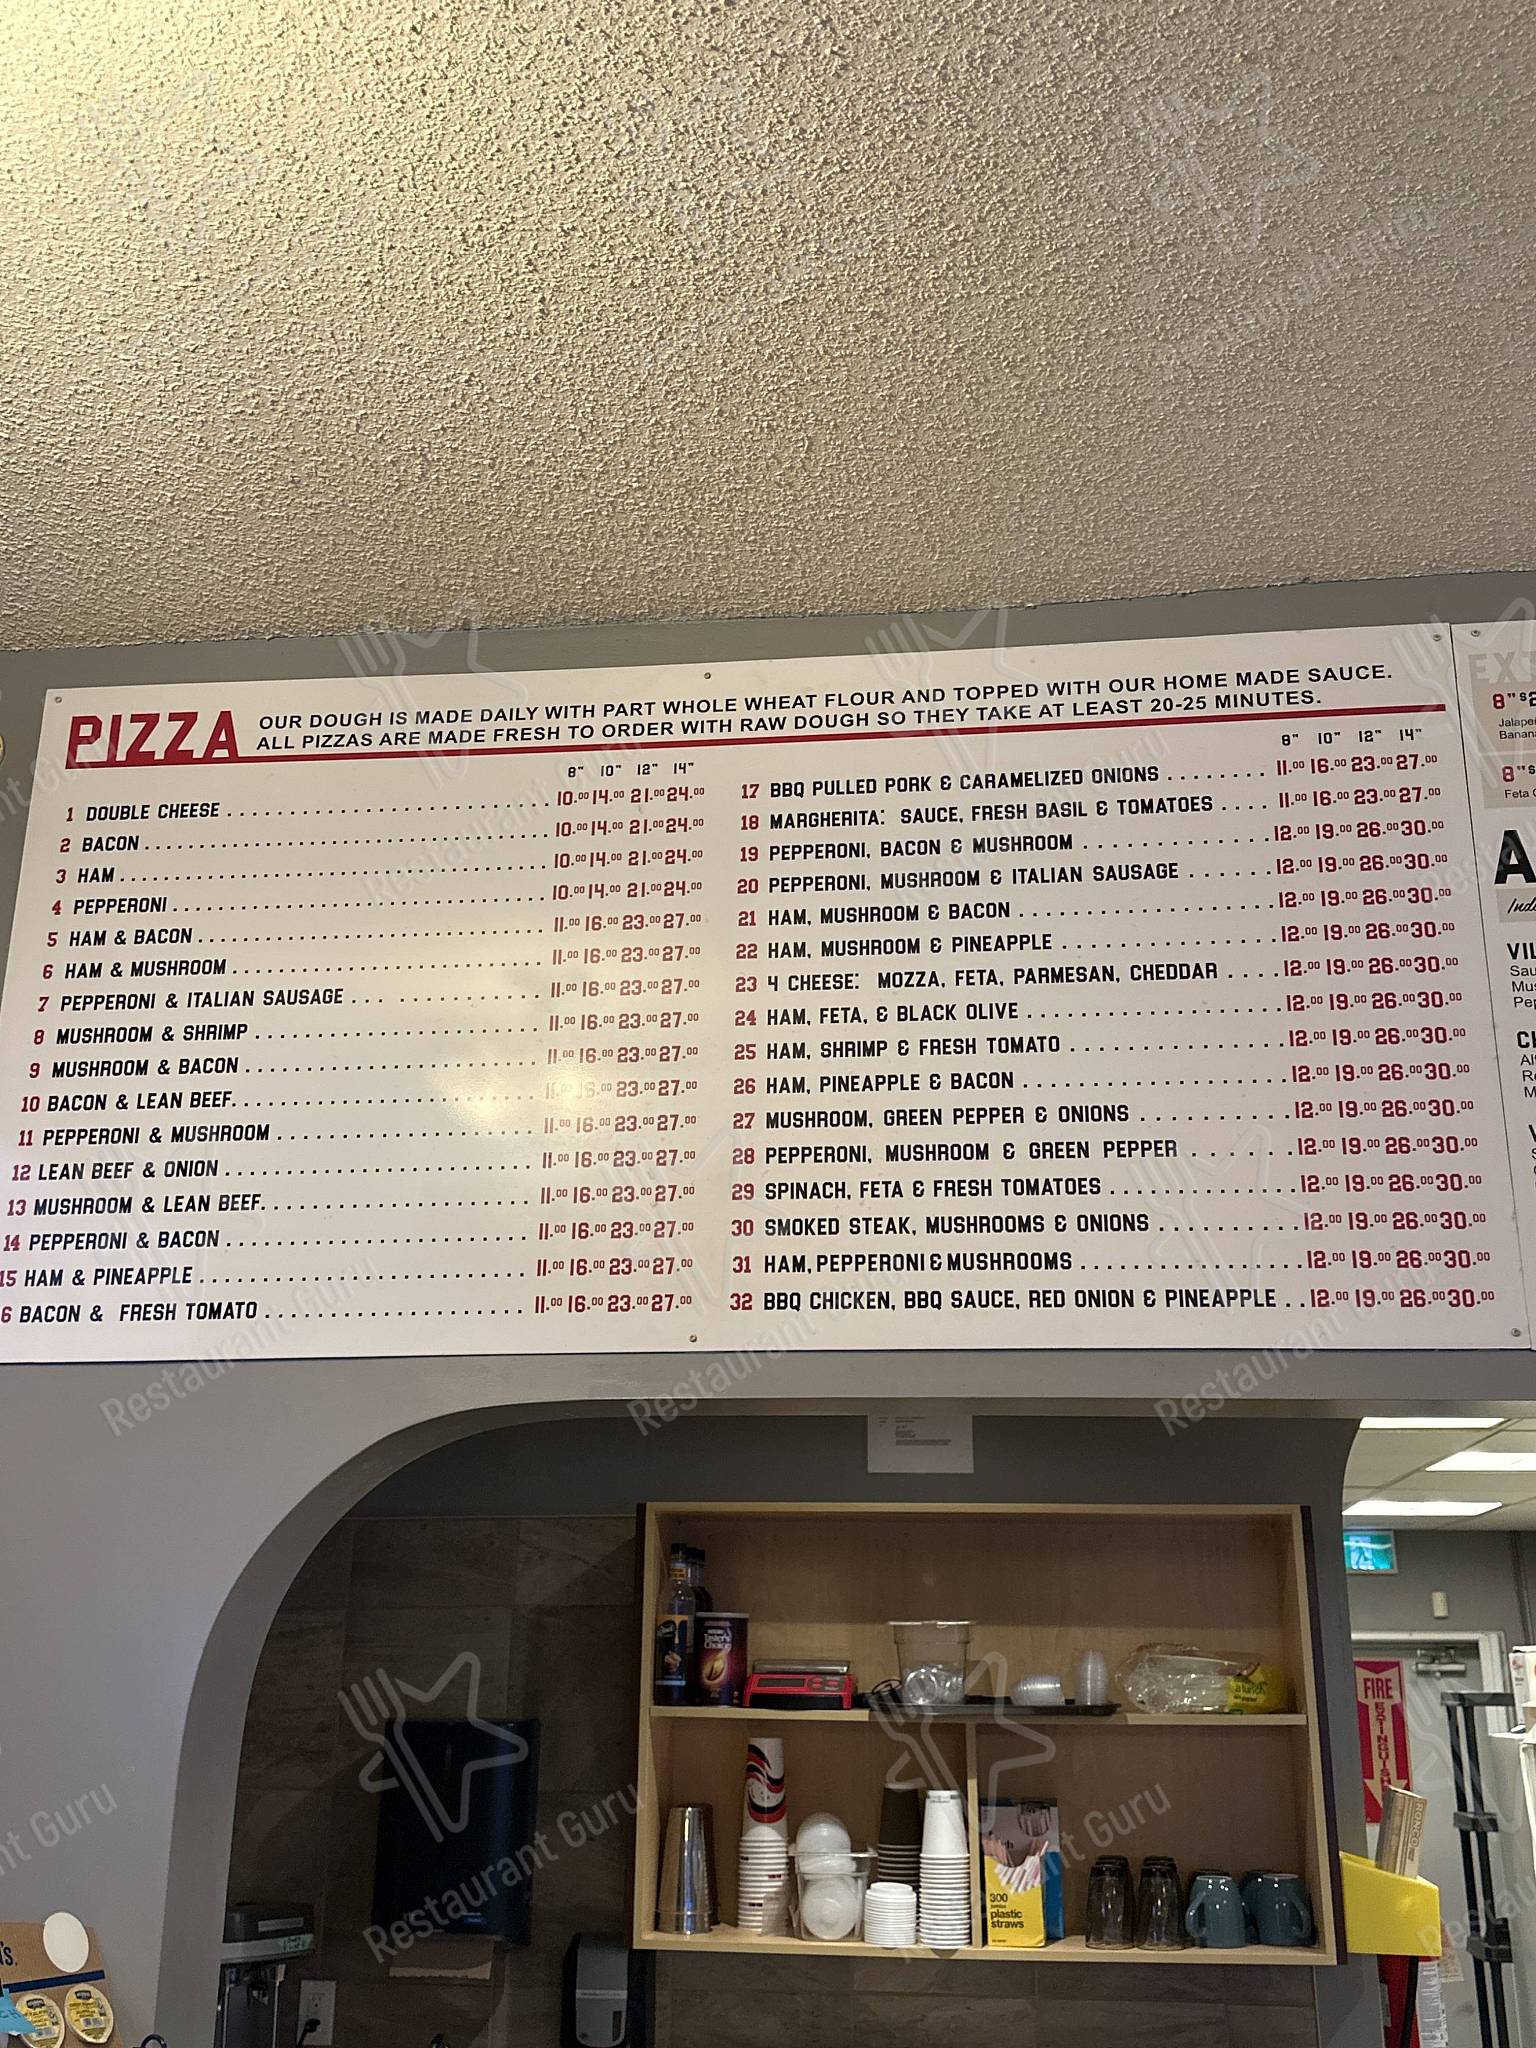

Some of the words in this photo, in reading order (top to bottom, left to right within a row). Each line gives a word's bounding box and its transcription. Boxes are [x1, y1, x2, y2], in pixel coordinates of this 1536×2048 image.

[260, 715, 302, 729] OUR
[310, 712, 382, 728] DOUGH
[390, 712, 407, 725] IS
[416, 710, 472, 724] MADE
[481, 707, 539, 722] DAILY
[545, 705, 595, 719] WITH
[604, 702, 656, 717] PART
[663, 698, 736, 714] WHOLE
[744, 695, 817, 711] WHEAT
[825, 691, 895, 707] FLOUR
[901, 689, 945, 703] AND
[953, 684, 1038, 701] TOPPED
[1047, 680, 1100, 696] WITH
[1109, 678, 1156, 693] OUR
[1164, 673, 1227, 690] HOME
[1236, 669, 1300, 686] MADE
[1308, 665, 1391, 682] SAUCE.
[256, 736, 294, 750] ALL
[302, 733, 372, 748] PIZZAS
[379, 731, 421, 746] ARE
[429, 729, 486, 744] MADE
[494, 726, 560, 742] FRESH
[568, 725, 594, 739] TO
[602, 722, 674, 737] ORDER
[681, 719, 732, 734] WITH
[741, 716, 787, 732] RAW
[795, 713, 868, 729] DOUGH
[877, 711, 905, 725] SO
[913, 708, 969, 724] THEY
[976, 705, 1031, 720] TAKE
[1038, 703, 1064, 718] AT
[1073, 699, 1143, 716] LEAST
[1151, 696, 1206, 712] 20-25
[1215, 690, 1321, 708] MINUTES.
[66, 710, 240, 769] PIZZA
[742, 784, 759, 799] 17
[771, 782, 804, 798] BBQ
[813, 779, 877, 796] PULLED
[885, 776, 932, 793] PORK
[940, 775, 951, 790] &
[960, 770, 1083, 790] CARAMELIZED
[1092, 766, 1158, 784] ONIONS
[1505, 789, 1529, 798] Feta
[66, 807, 73, 822] 1
[86, 805, 150, 821] DOUBLE
[158, 802, 220, 819] CHEESE
[741, 815, 759, 830] 18
[770, 809, 885, 829] MARGHERITA:
[901, 806, 963, 824] SAUCE,
[972, 804, 1027, 821] FRESH
[1036, 801, 1087, 819] BASIL
[1096, 800, 1108, 816] &
[1117, 796, 1212, 815] TOMATOES
[60, 838, 71, 853] 2
[82, 835, 139, 852] BACON
[737, 878, 758, 894] 20
[769, 874, 870, 893] PEPPERONI,
[881, 870, 980, 889] MUSHROOM
[991, 869, 1002, 885] &
[1012, 866, 1082, 884] ITALIAN
[1093, 863, 1178, 881] SAUSAGE
[52, 900, 61, 915] 4
[74, 897, 167, 915] PEPPERONI
[47, 932, 58, 947] 5
[69, 930, 107, 947] HAM
[114, 930, 126, 945] &
[134, 928, 192, 944] BACON
[736, 976, 757, 992] 23
[768, 976, 778, 991] 4
[788, 973, 859, 991] CHEESE:
[878, 971, 945, 988] MOZZA,
[955, 969, 1004, 986] FETA,
[1014, 965, 1120, 984] PARMESAN,
[1130, 962, 1217, 981] CHEDDAR
[38, 996, 49, 1012] 7
[61, 993, 156, 1011] PEPPERONI
[165, 993, 178, 1008] &
[187, 991, 254, 1008] ITALIAN
[263, 988, 343, 1005] SAUSAGE
[34, 1029, 45, 1045] 8
[56, 1026, 153, 1044] MUSHROOM
[162, 1026, 174, 1041] &
[183, 1024, 248, 1041] SHRIMP
[735, 1044, 756, 1060] 25
[767, 1042, 810, 1060] HAM,
[821, 1040, 887, 1058] SHRIMP
[898, 1040, 909, 1056] &
[920, 1038, 976, 1055] FRESH
[986, 1036, 1060, 1054] TOMATO
[12, 1165, 31, 1181] 12
[38, 1163, 84, 1180] LEAN
[91, 1162, 134, 1179] BEEF
[143, 1162, 155, 1178] &
[164, 1160, 218, 1177] ONION
[732, 1219, 753, 1236] 30
[765, 1218, 839, 1236] SMOKED
[849, 1217, 916, 1236] STEAK,
[926, 1215, 1044, 1234] MUSHROOMS
[1055, 1215, 1067, 1232] &
[1077, 1214, 1149, 1232] ONIONS
[3, 1234, 20, 1251] 14
[29, 1232, 127, 1251] PEPPERONI
[136, 1232, 149, 1248] &
[158, 1230, 219, 1248] BACON
[730, 1293, 752, 1310] 32
[764, 1292, 801, 1312] BBQ
[810, 1291, 895, 1311] CHICKEN,
[904, 1291, 942, 1310] BBQ
[951, 1290, 1020, 1310] SAUCE,
[1029, 1290, 1065, 1308] RED
[1075, 1289, 1134, 1308] ONION
[1143, 1289, 1156, 1307] &
[1165, 1289, 1276, 1307] PINEAPPLE
[1363, 1678, 1393, 1699] FIRE
[989, 1893, 1008, 1903] 300
[990, 1909, 1023, 1920] plastic
[991, 1919, 1024, 1929] straws
